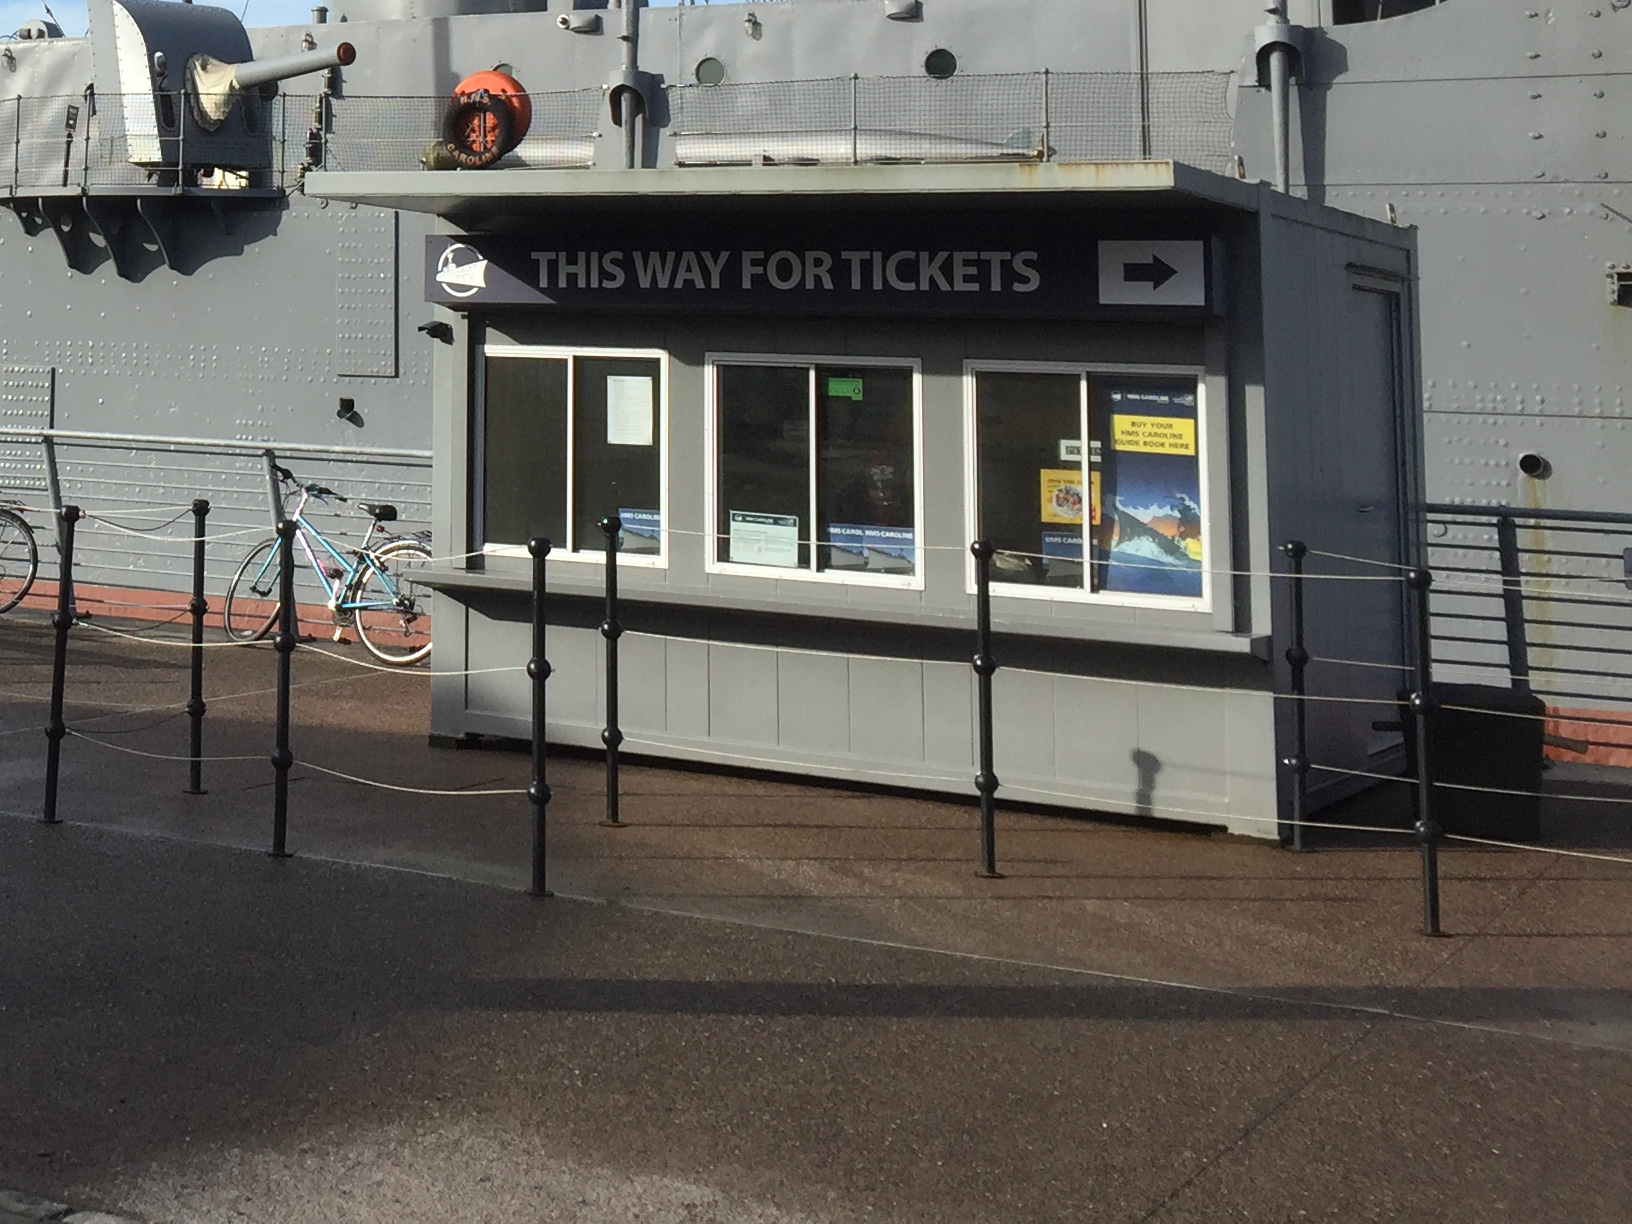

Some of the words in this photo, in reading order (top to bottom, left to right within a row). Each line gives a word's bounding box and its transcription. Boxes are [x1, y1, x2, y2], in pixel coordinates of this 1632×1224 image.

[531, 251, 625, 289] THIS
[632, 251, 730, 289] WAY
[741, 250, 834, 290] FOR
[841, 250, 1041, 292] TICKETS
[1151, 422, 1173, 430] YOUR
[1121, 429, 1139, 437] HMS
[1142, 431, 1183, 440] CAROLINE
[1115, 438, 1139, 446] GUIDE
[1143, 440, 1166, 448] BOOK
